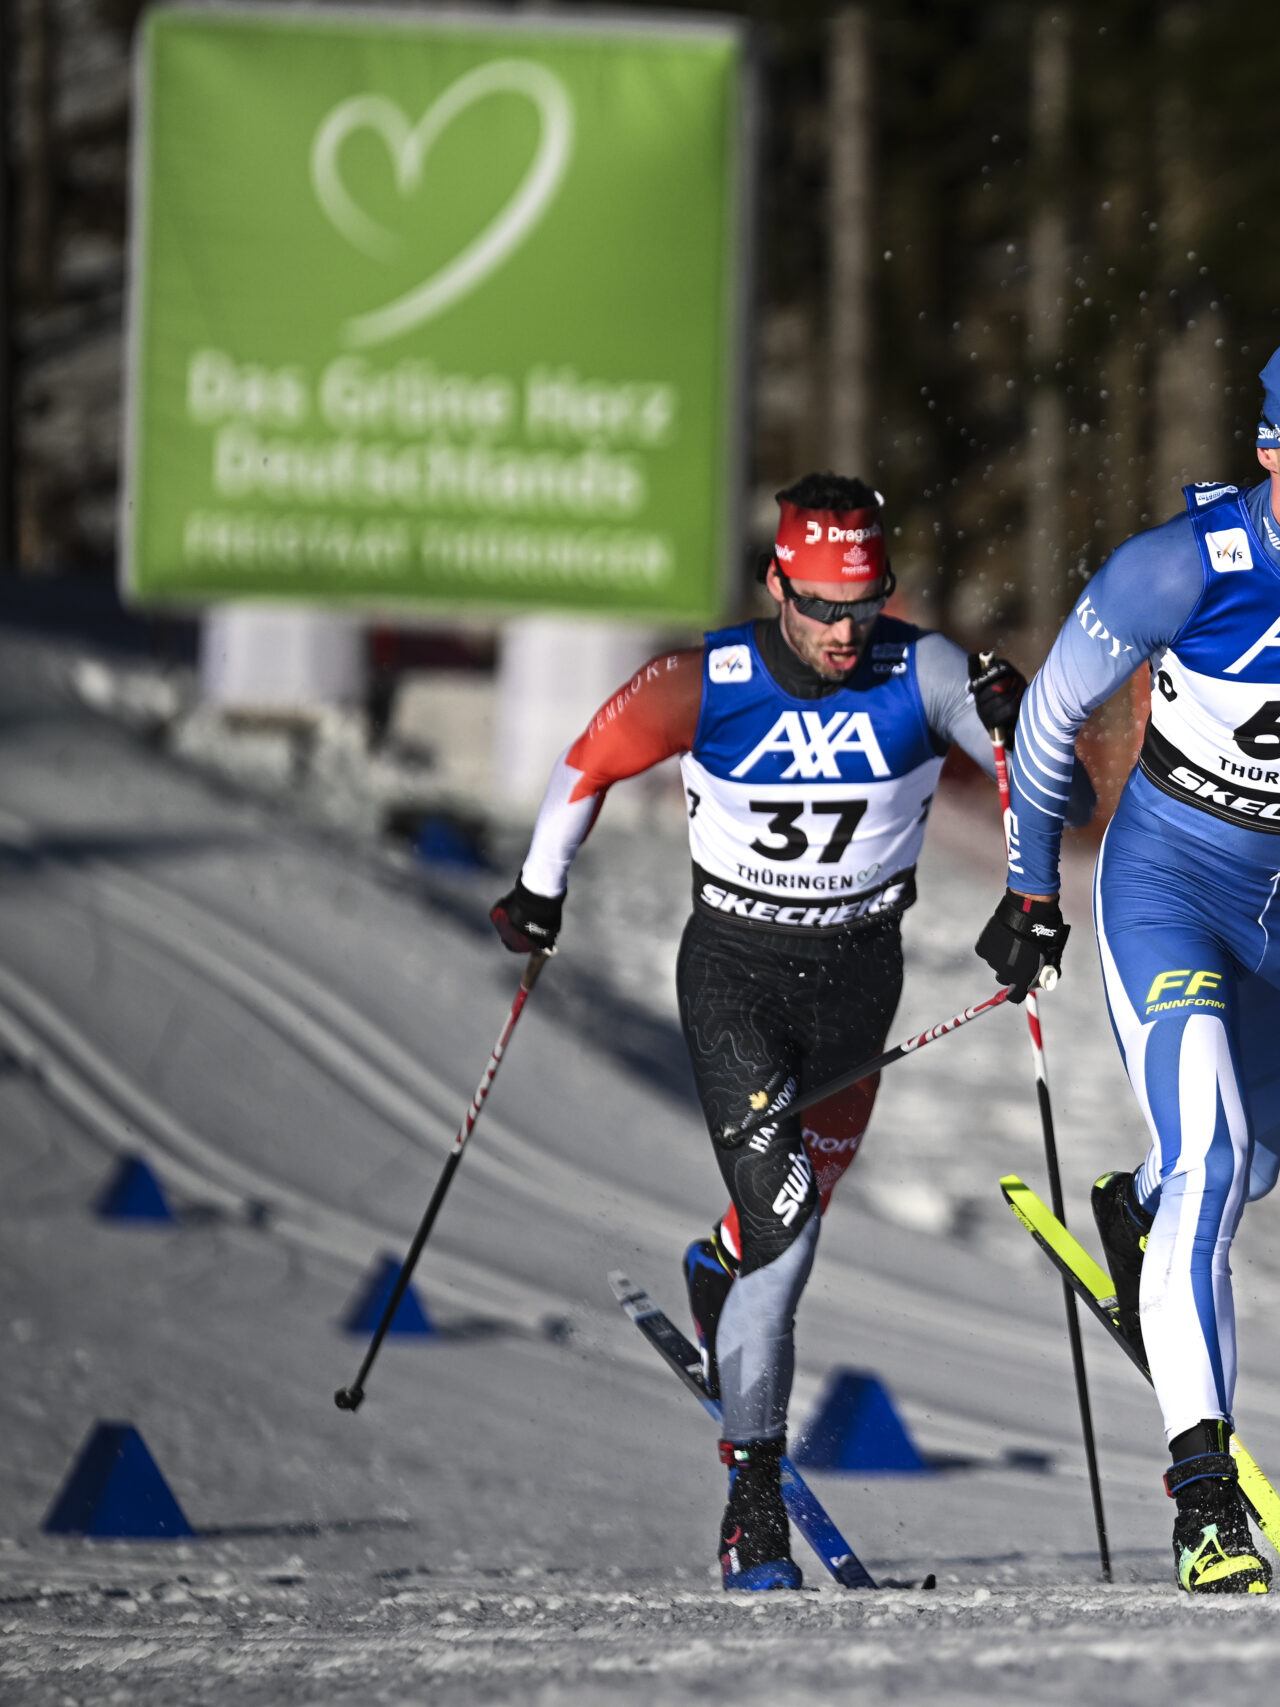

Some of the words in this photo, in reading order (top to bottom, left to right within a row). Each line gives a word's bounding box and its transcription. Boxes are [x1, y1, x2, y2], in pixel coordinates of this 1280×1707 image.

[1076, 595, 1134, 659] KPY
[729, 711, 892, 780] AXA
[749, 798, 868, 864] 37
[736, 863, 853, 890] THÜRINGEN
[700, 882, 906, 927] SKECHERS
[1145, 970, 1222, 1004] FF
[1145, 998, 1226, 1016] FINNFORM
